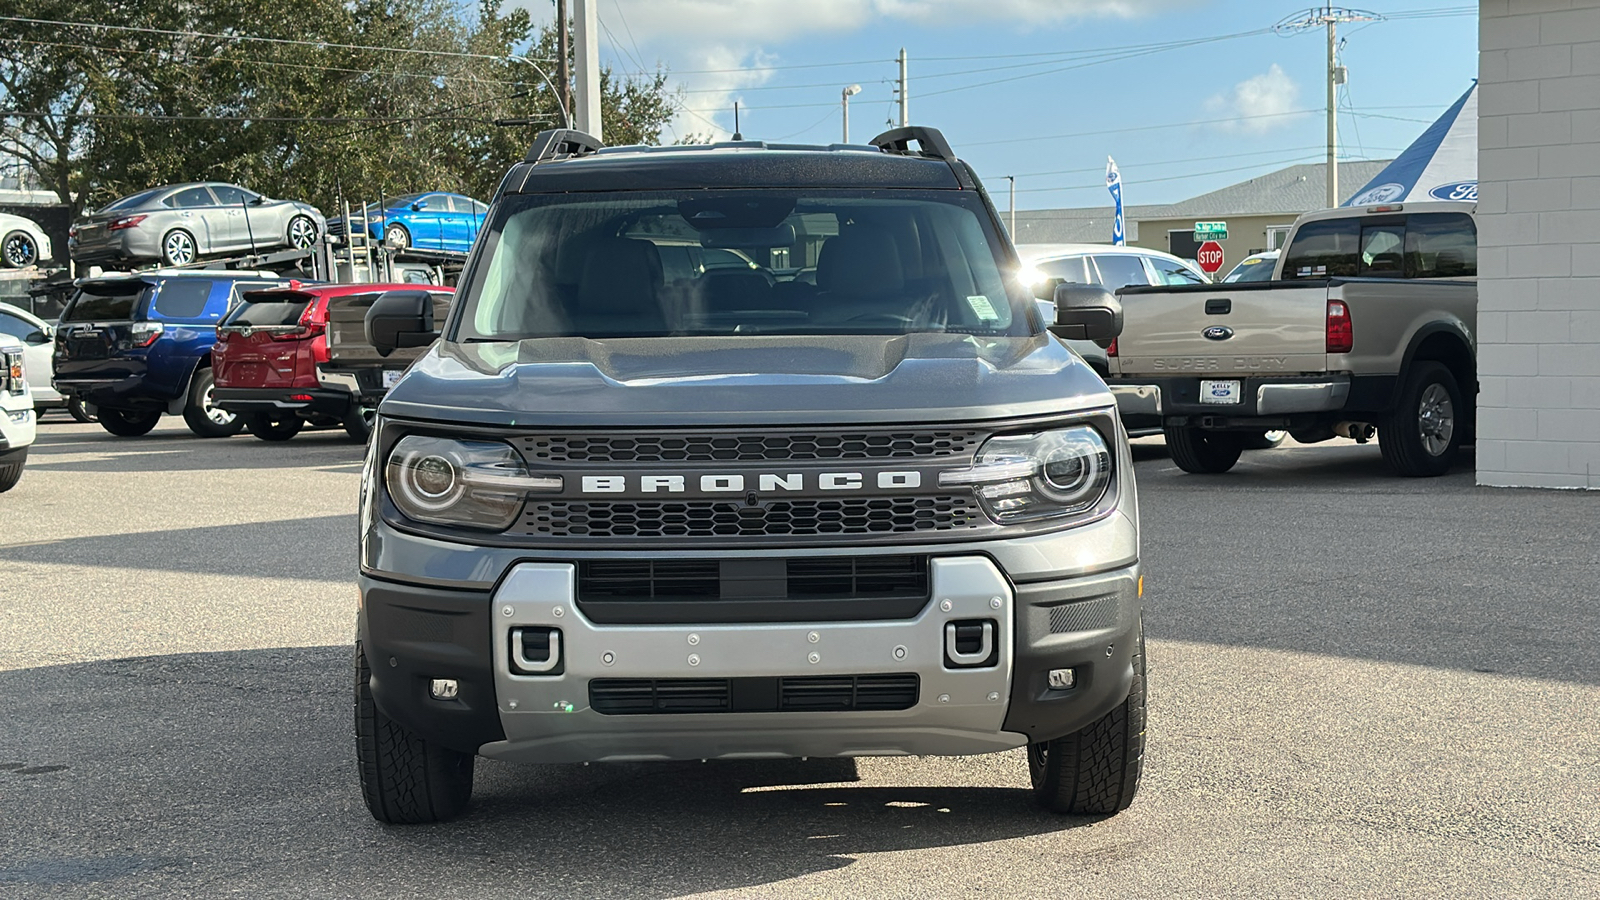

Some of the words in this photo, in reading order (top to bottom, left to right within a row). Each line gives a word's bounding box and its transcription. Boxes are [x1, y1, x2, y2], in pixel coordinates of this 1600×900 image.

[1199, 250, 1222, 264] STOP
[1153, 357, 1219, 370] SUPER
[1233, 356, 1288, 370] DUTY
[581, 471, 922, 493] BRONCO
